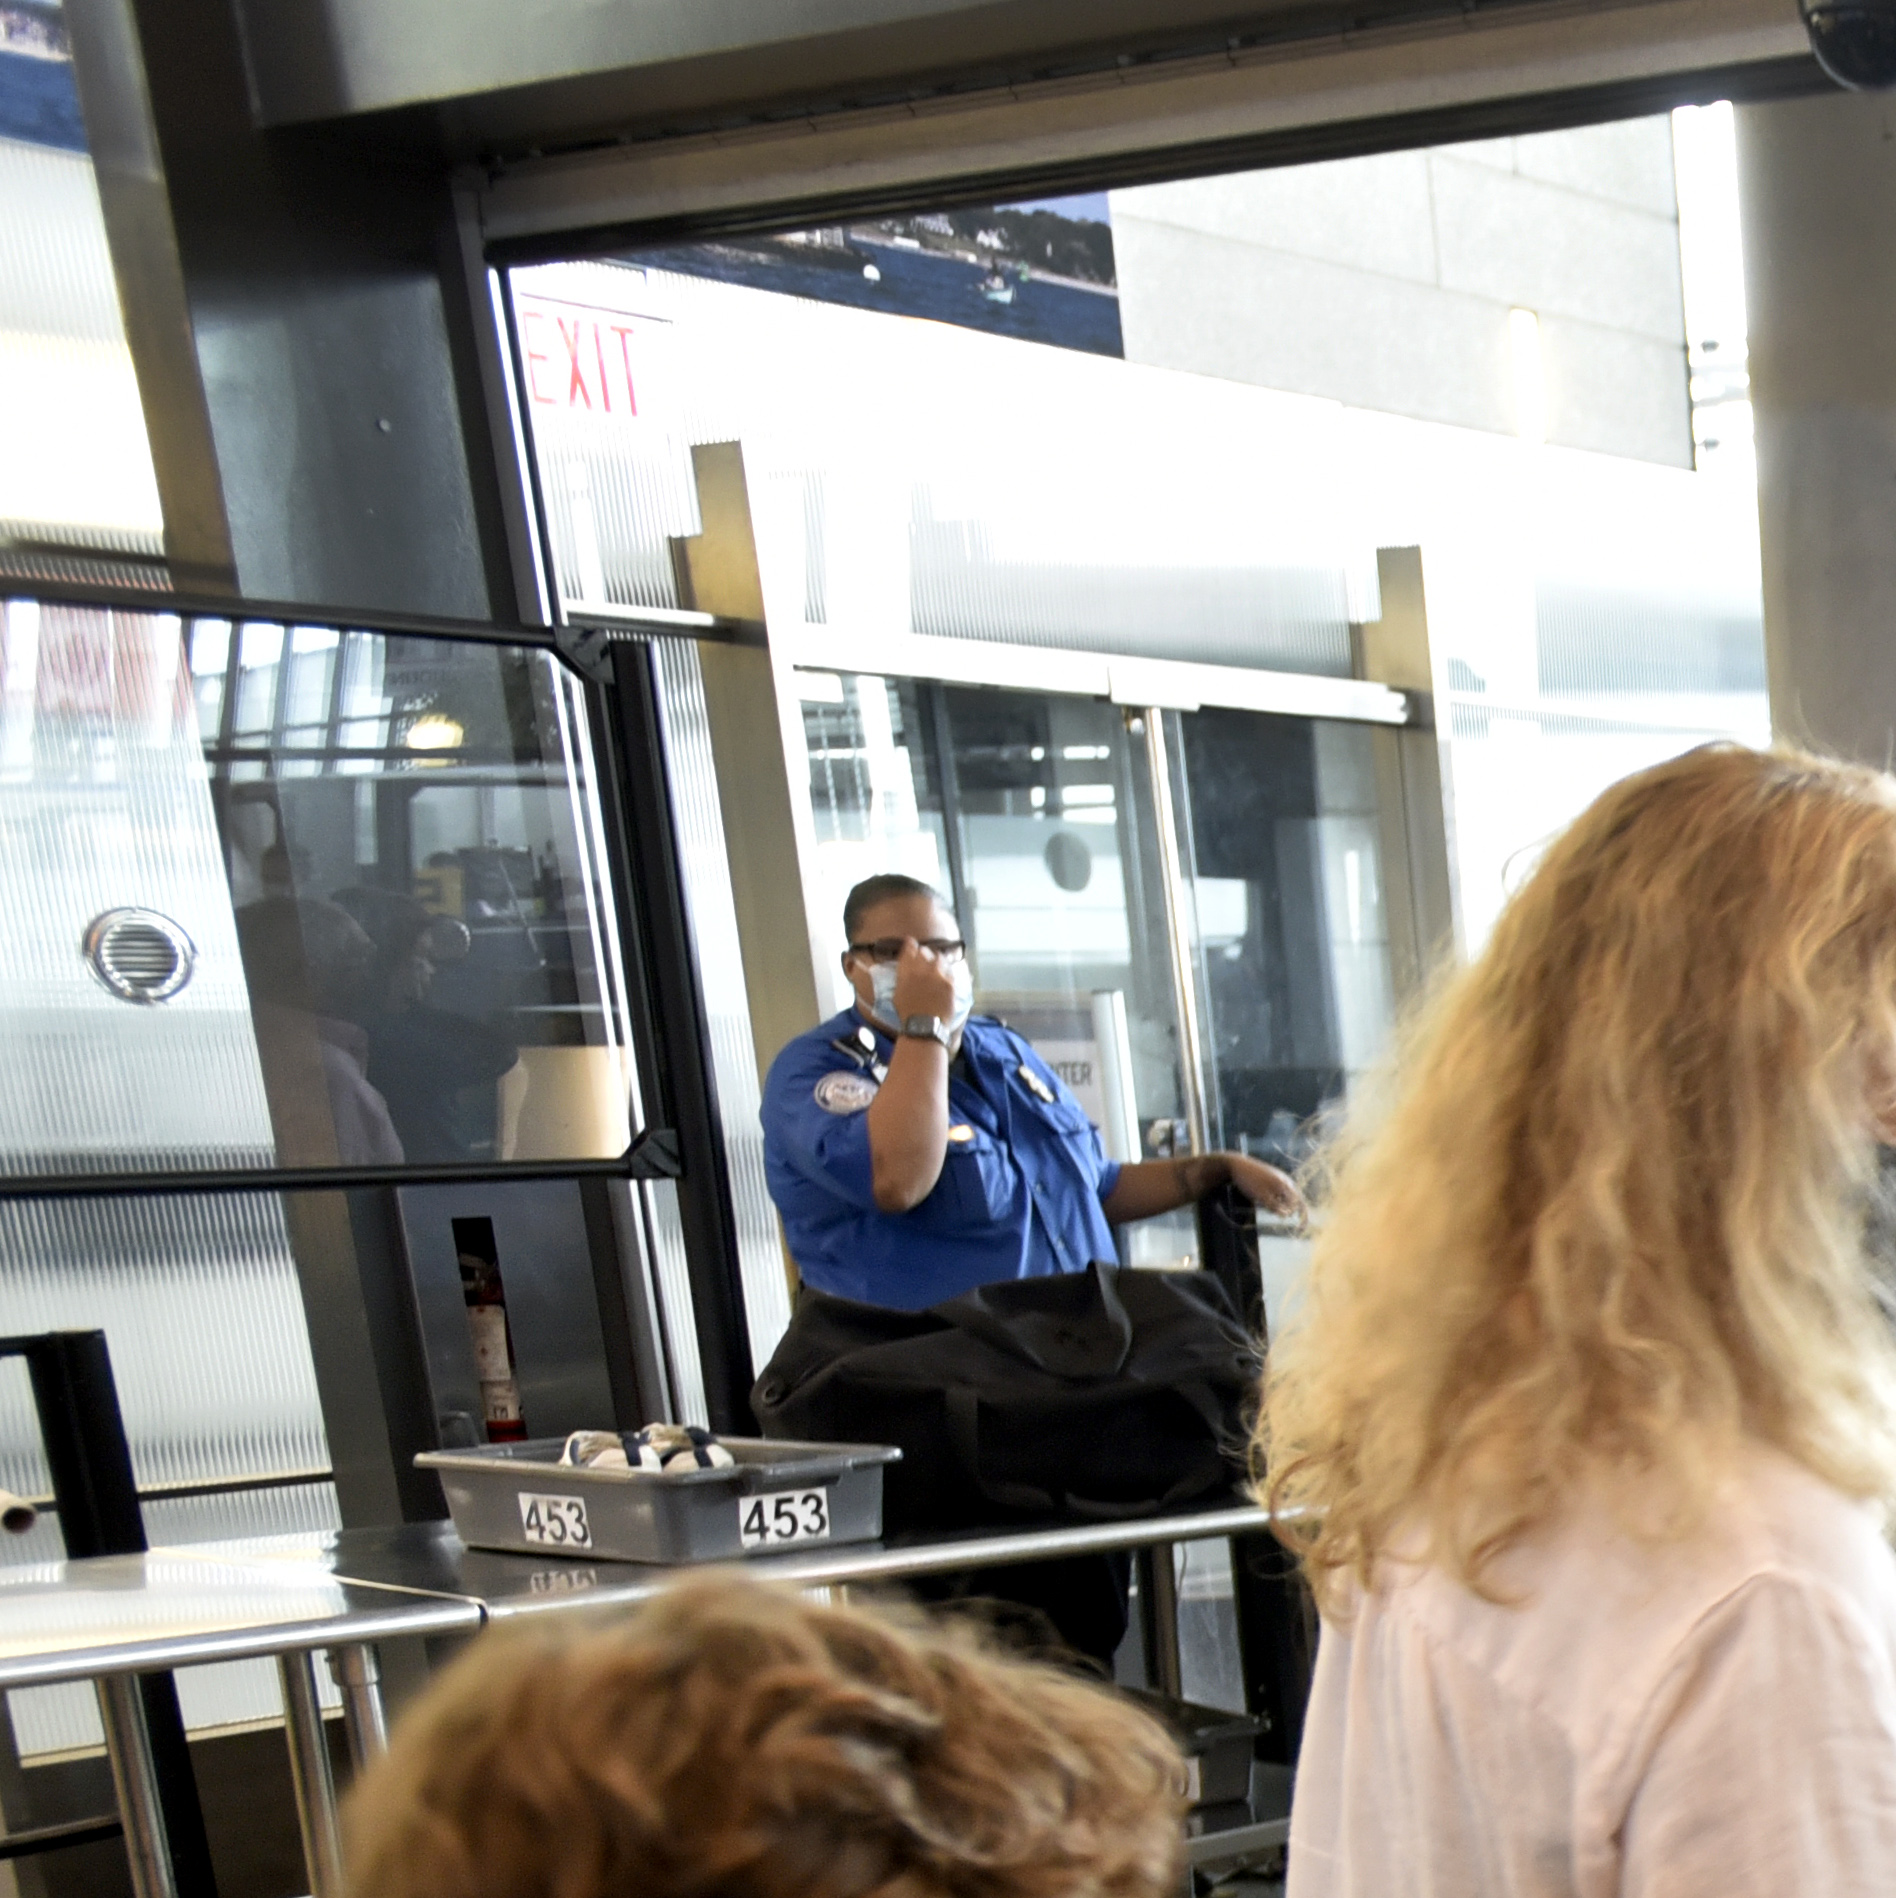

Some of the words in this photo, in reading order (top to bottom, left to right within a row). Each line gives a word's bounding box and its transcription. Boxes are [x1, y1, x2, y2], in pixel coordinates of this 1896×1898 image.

[522, 311, 638, 417] EXIT
[525, 1500, 589, 1544] 453
[742, 1493, 827, 1541] 453
